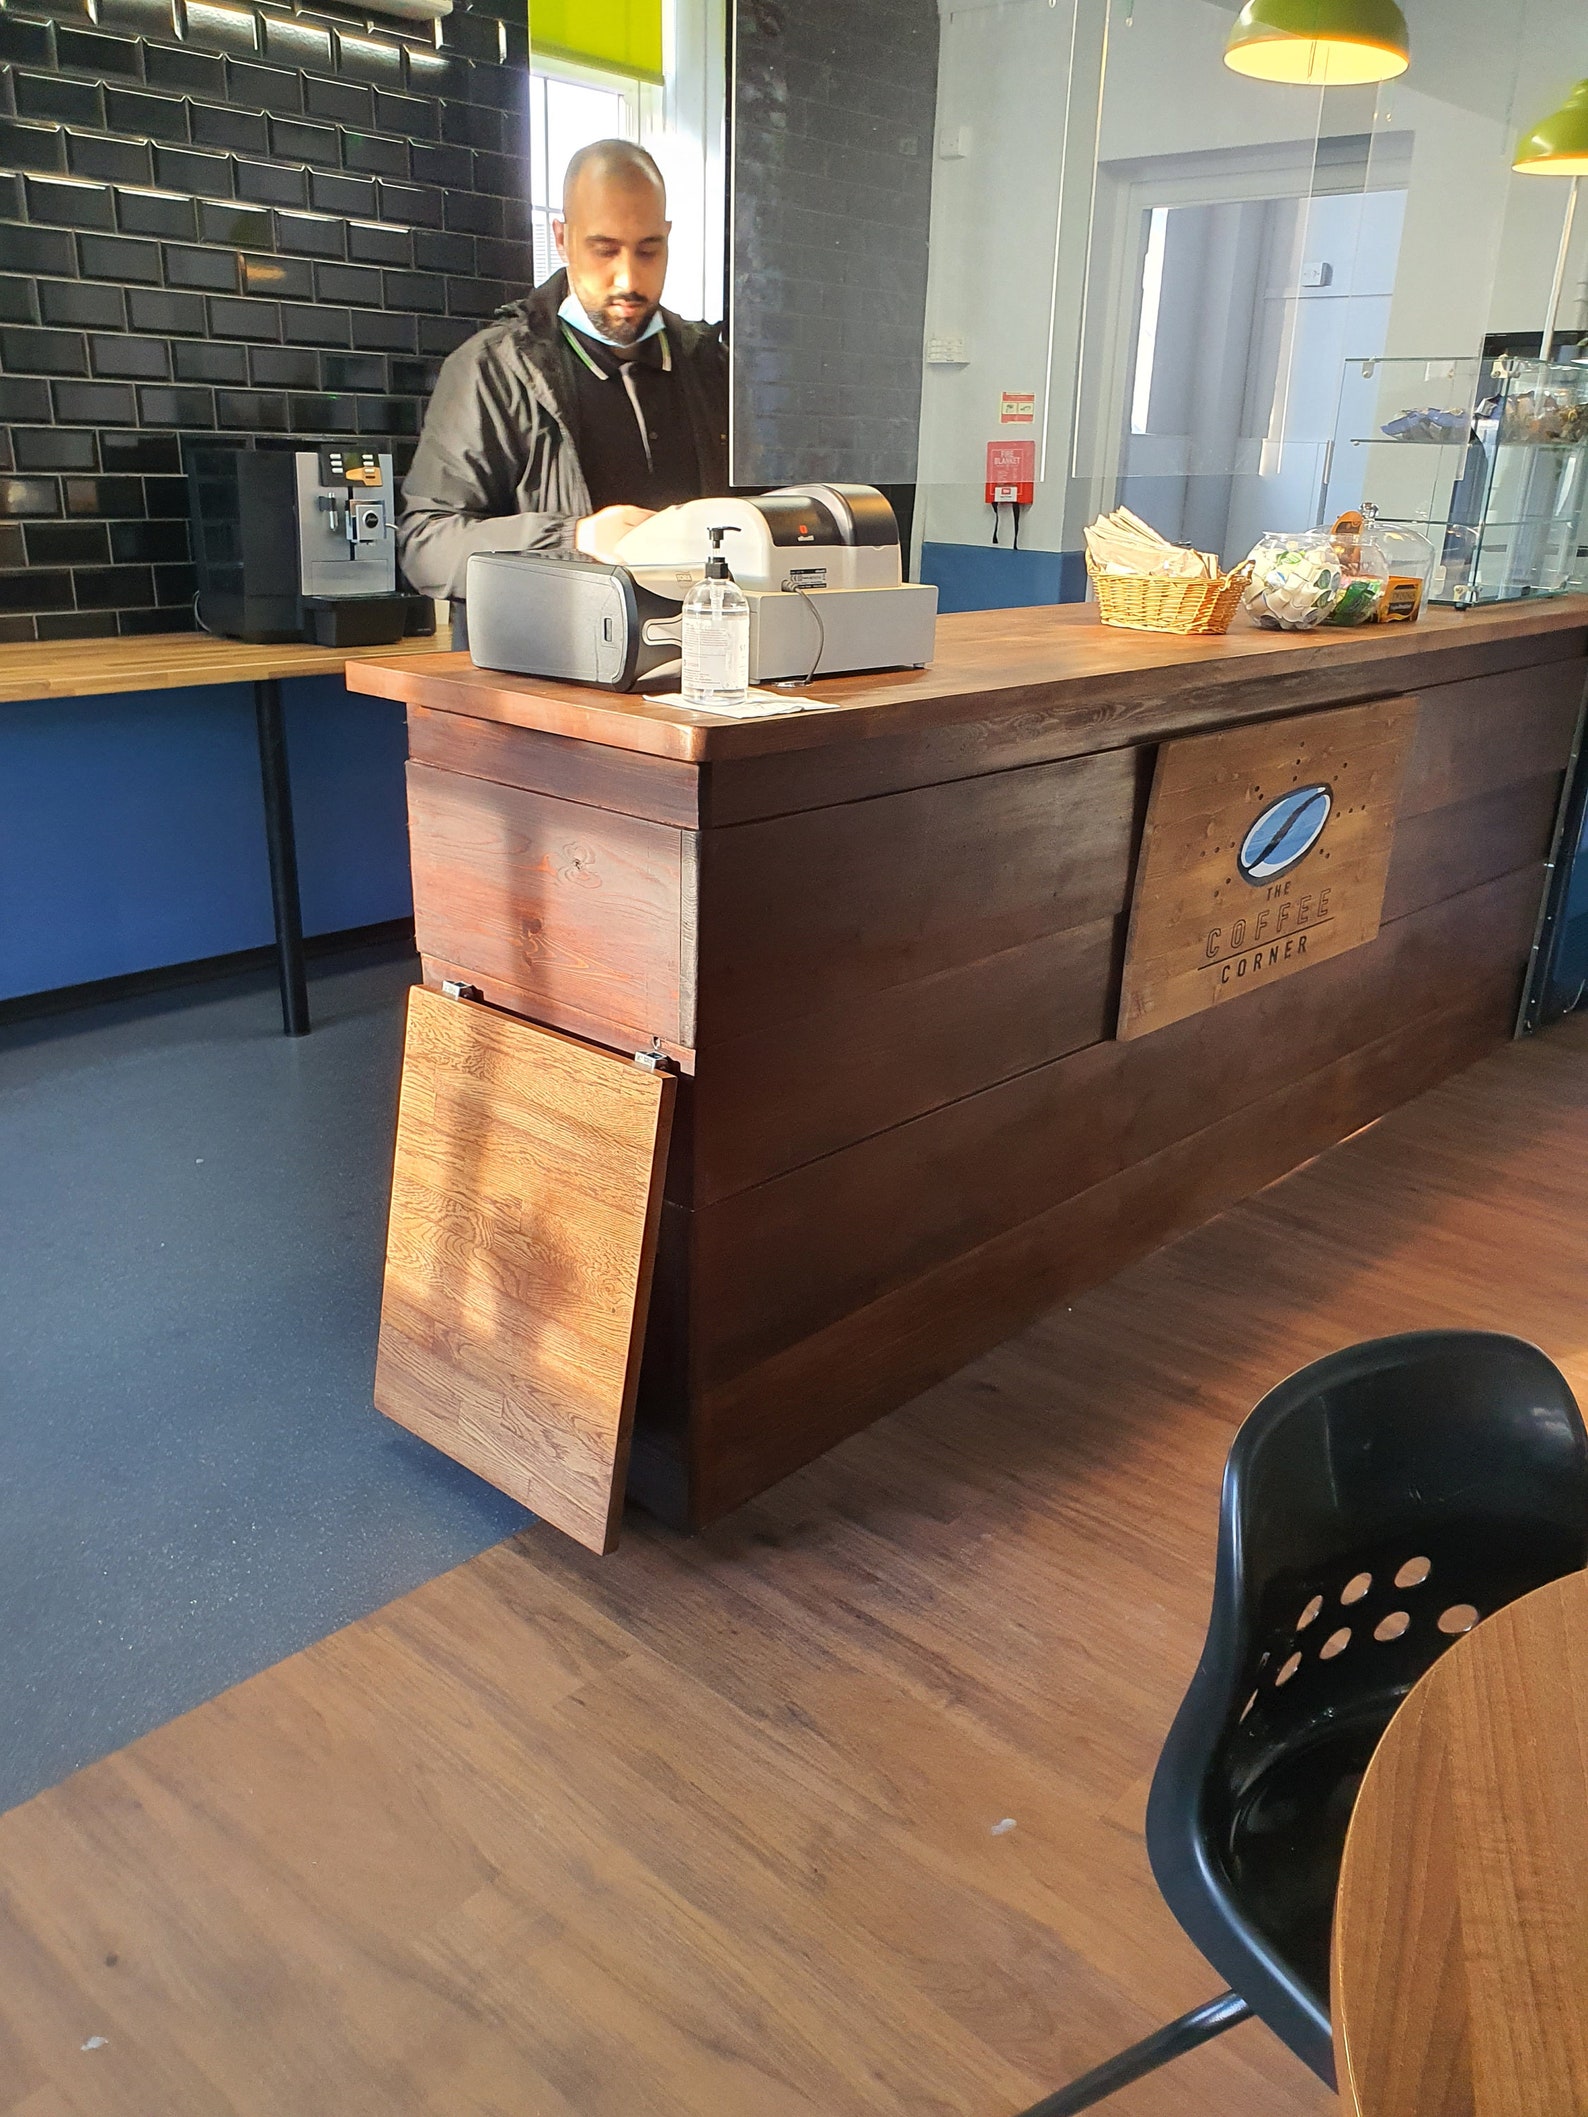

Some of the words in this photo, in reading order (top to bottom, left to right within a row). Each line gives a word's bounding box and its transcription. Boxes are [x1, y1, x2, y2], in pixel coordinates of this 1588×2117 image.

[994, 457, 1020, 465] BLANKET
[1266, 881, 1292, 901] THE
[1206, 888, 1332, 958] COFFEE
[1221, 935, 1308, 984] CORNER
